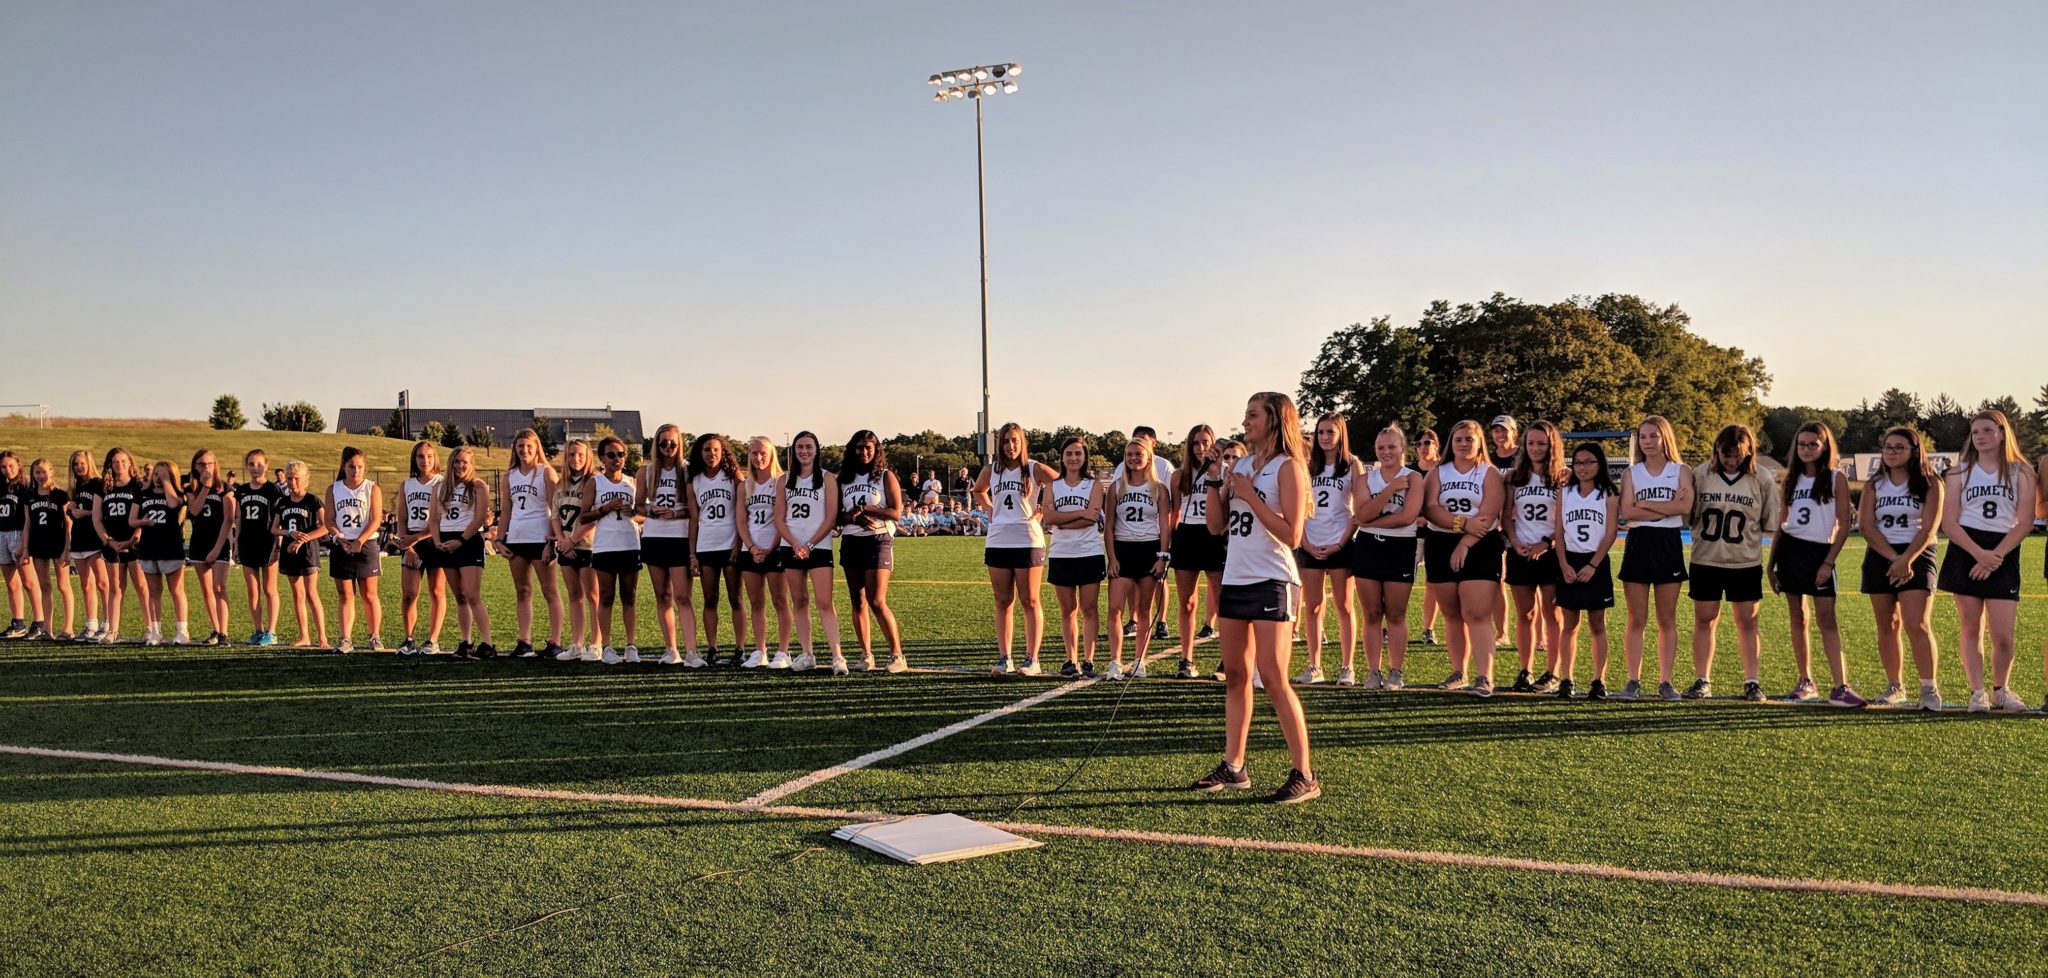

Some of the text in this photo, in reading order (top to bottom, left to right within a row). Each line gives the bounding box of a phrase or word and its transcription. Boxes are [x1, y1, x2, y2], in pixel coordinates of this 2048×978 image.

[511, 485, 538, 496] COMETS
[845, 484, 877, 498] COMETS
[1311, 477, 1344, 491] OMETS
[1440, 481, 1480, 495] COMETS
[407, 491, 431, 504] COMET
[600, 491, 634, 504] COMETS
[700, 488, 732, 505] COMETS
[787, 488, 819, 501] COMETS
[1118, 493, 1154, 506] COMETS
[1318, 491, 1329, 507] 2
[1516, 486, 1557, 500] COMETS
[1636, 487, 1677, 501] COMETS
[1700, 492, 1754, 507] PENN MANOR
[1966, 485, 2014, 502] COMETS
[337, 498, 365, 511] COMET
[518, 496, 527, 510] 7
[656, 494, 676, 508] 25
[851, 495, 867, 507] 14
[1004, 494, 1013, 510] 4
[1055, 496, 1089, 510] COMETS
[1446, 498, 1472, 513] 39
[1875, 495, 1920, 510] COMETS
[108, 502, 126, 516] 28
[203, 504, 211, 517] 3
[246, 505, 259, 519] 12
[411, 506, 429, 520] 35
[707, 504, 725, 520] 30
[792, 503, 810, 518] 29
[1126, 507, 1144, 522] 21
[1523, 503, 1548, 521] 32
[1797, 506, 1810, 525] 3
[1983, 501, 1997, 520] 8
[39, 511, 48, 525] 2
[148, 510, 166, 523] 22
[343, 514, 361, 528] 24
[1230, 510, 1254, 537] 28
[1566, 509, 1604, 525] COMETS
[1881, 514, 1908, 529] 34
[288, 518, 297, 533] 6
[1701, 508, 1746, 544] 00
[1577, 525, 1590, 542] 5
